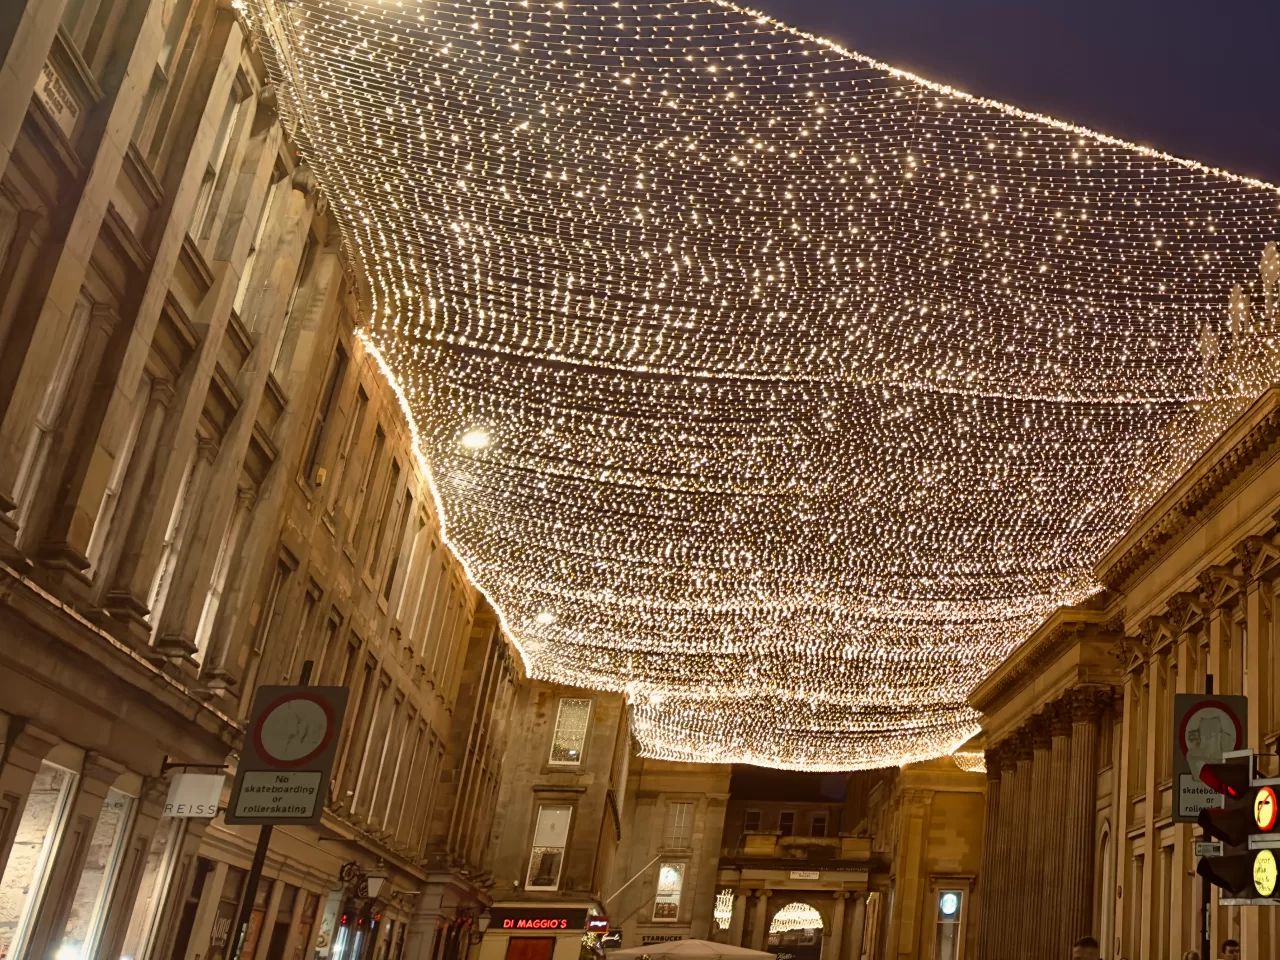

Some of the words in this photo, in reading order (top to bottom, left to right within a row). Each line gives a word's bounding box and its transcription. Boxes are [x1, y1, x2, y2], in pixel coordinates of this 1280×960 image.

[275, 775, 290, 784] No
[244, 785, 315, 794] skateboarding
[164, 803, 217, 816] REISS
[243, 805, 307, 815] rollerskating
[503, 918, 515, 929] DI
[516, 918, 568, 930] MAGGIO'S
